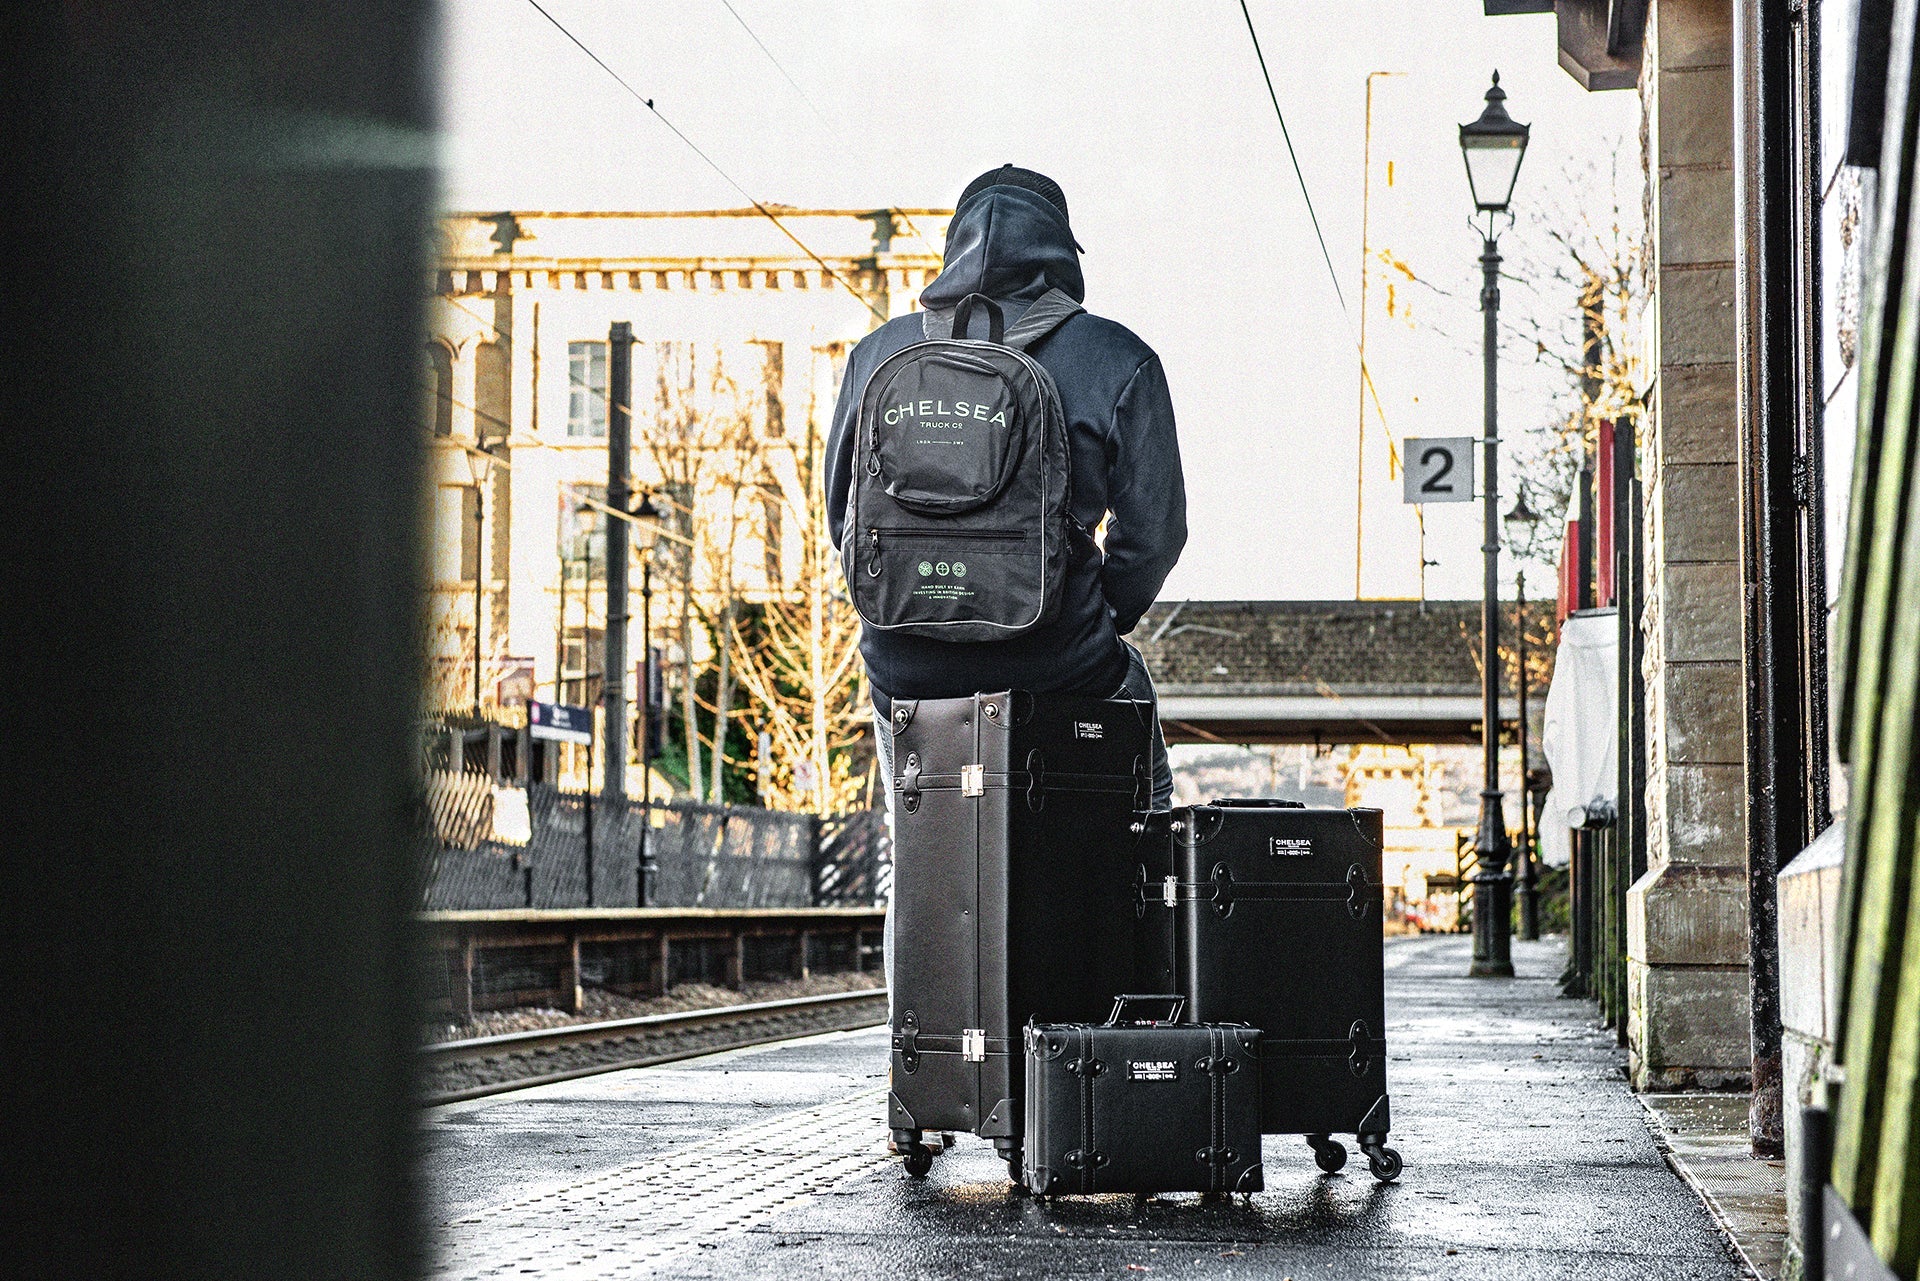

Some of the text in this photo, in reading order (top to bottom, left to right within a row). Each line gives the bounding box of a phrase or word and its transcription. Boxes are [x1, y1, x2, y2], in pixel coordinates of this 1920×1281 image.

[884, 400, 1007, 428] CHELSEA
[919, 421, 950, 429] TRUCK
[1421, 446, 1453, 493] 2
[1078, 722, 1103, 730] CHELSEA
[1132, 1061, 1175, 1069] CHELSEA
